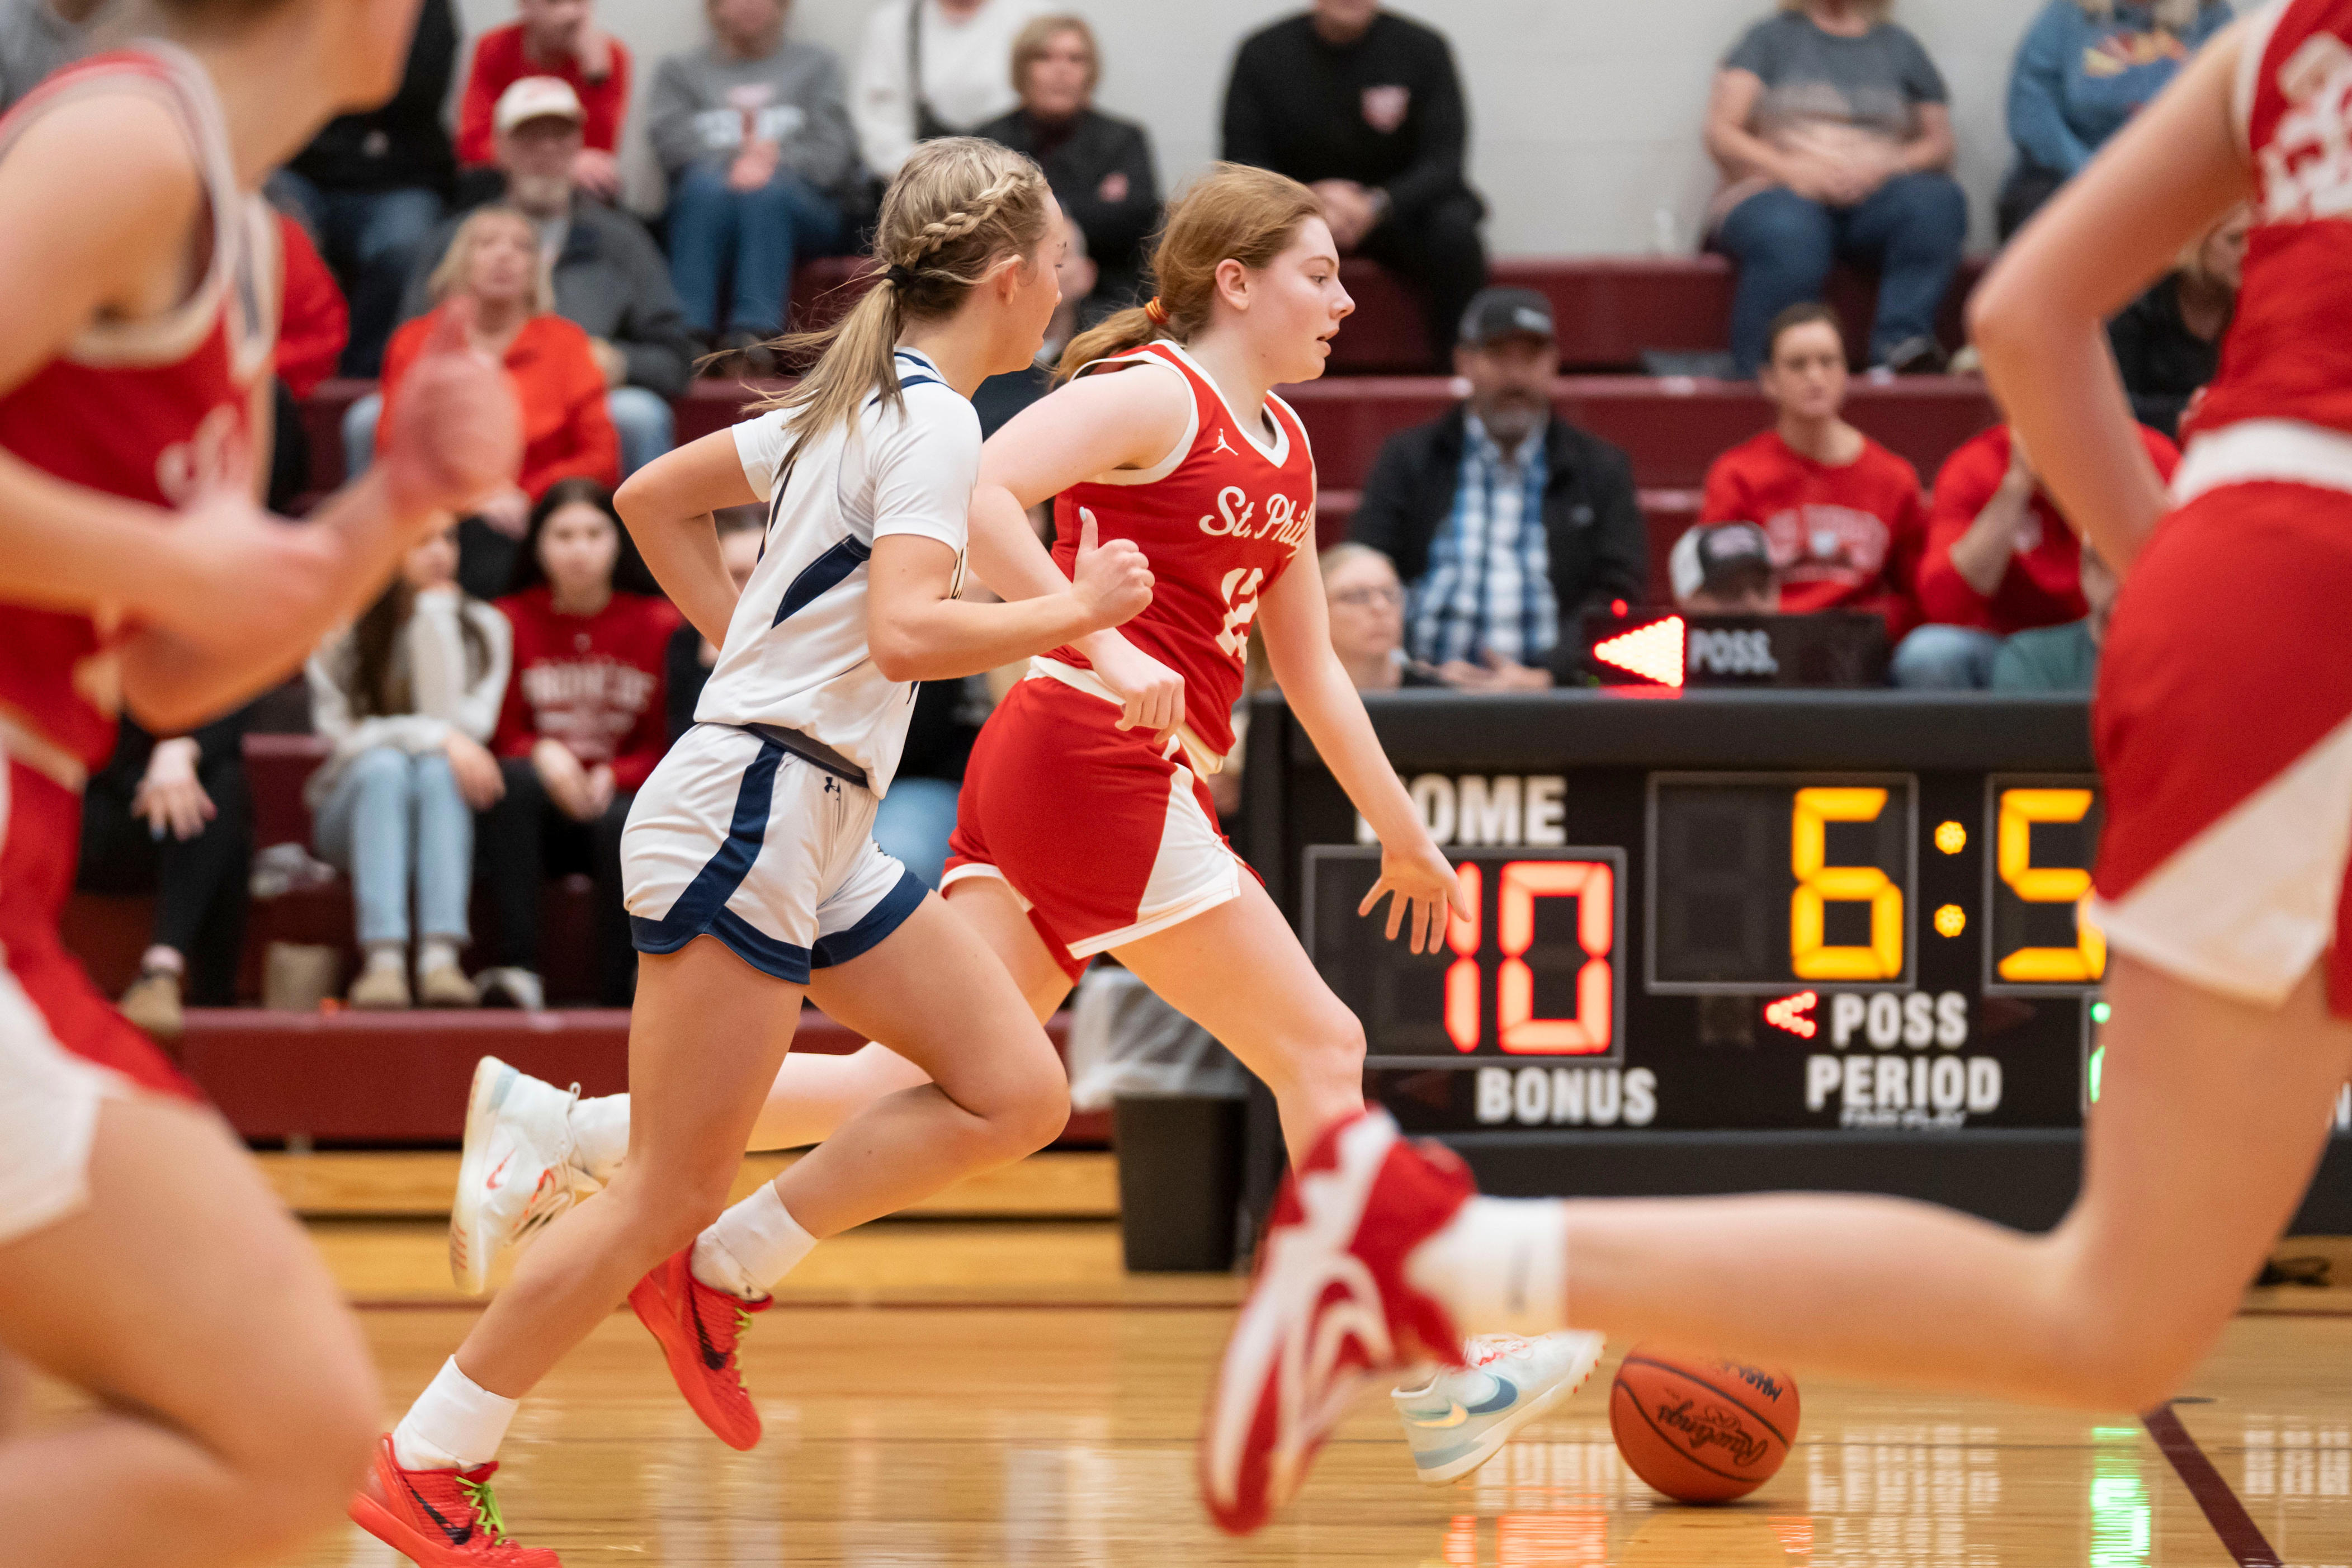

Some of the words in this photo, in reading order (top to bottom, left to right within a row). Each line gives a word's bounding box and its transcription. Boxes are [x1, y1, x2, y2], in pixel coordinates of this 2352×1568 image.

[1199, 486, 1253, 538] St.
[1254, 493, 1313, 551] Phil
[1689, 629, 1778, 673] POSS.
[1444, 861, 1614, 1055] 10
[1831, 991, 1968, 1049] POSS
[1476, 1067, 1657, 1126] BONUS
[1806, 1055, 2002, 1112] PERIOD
